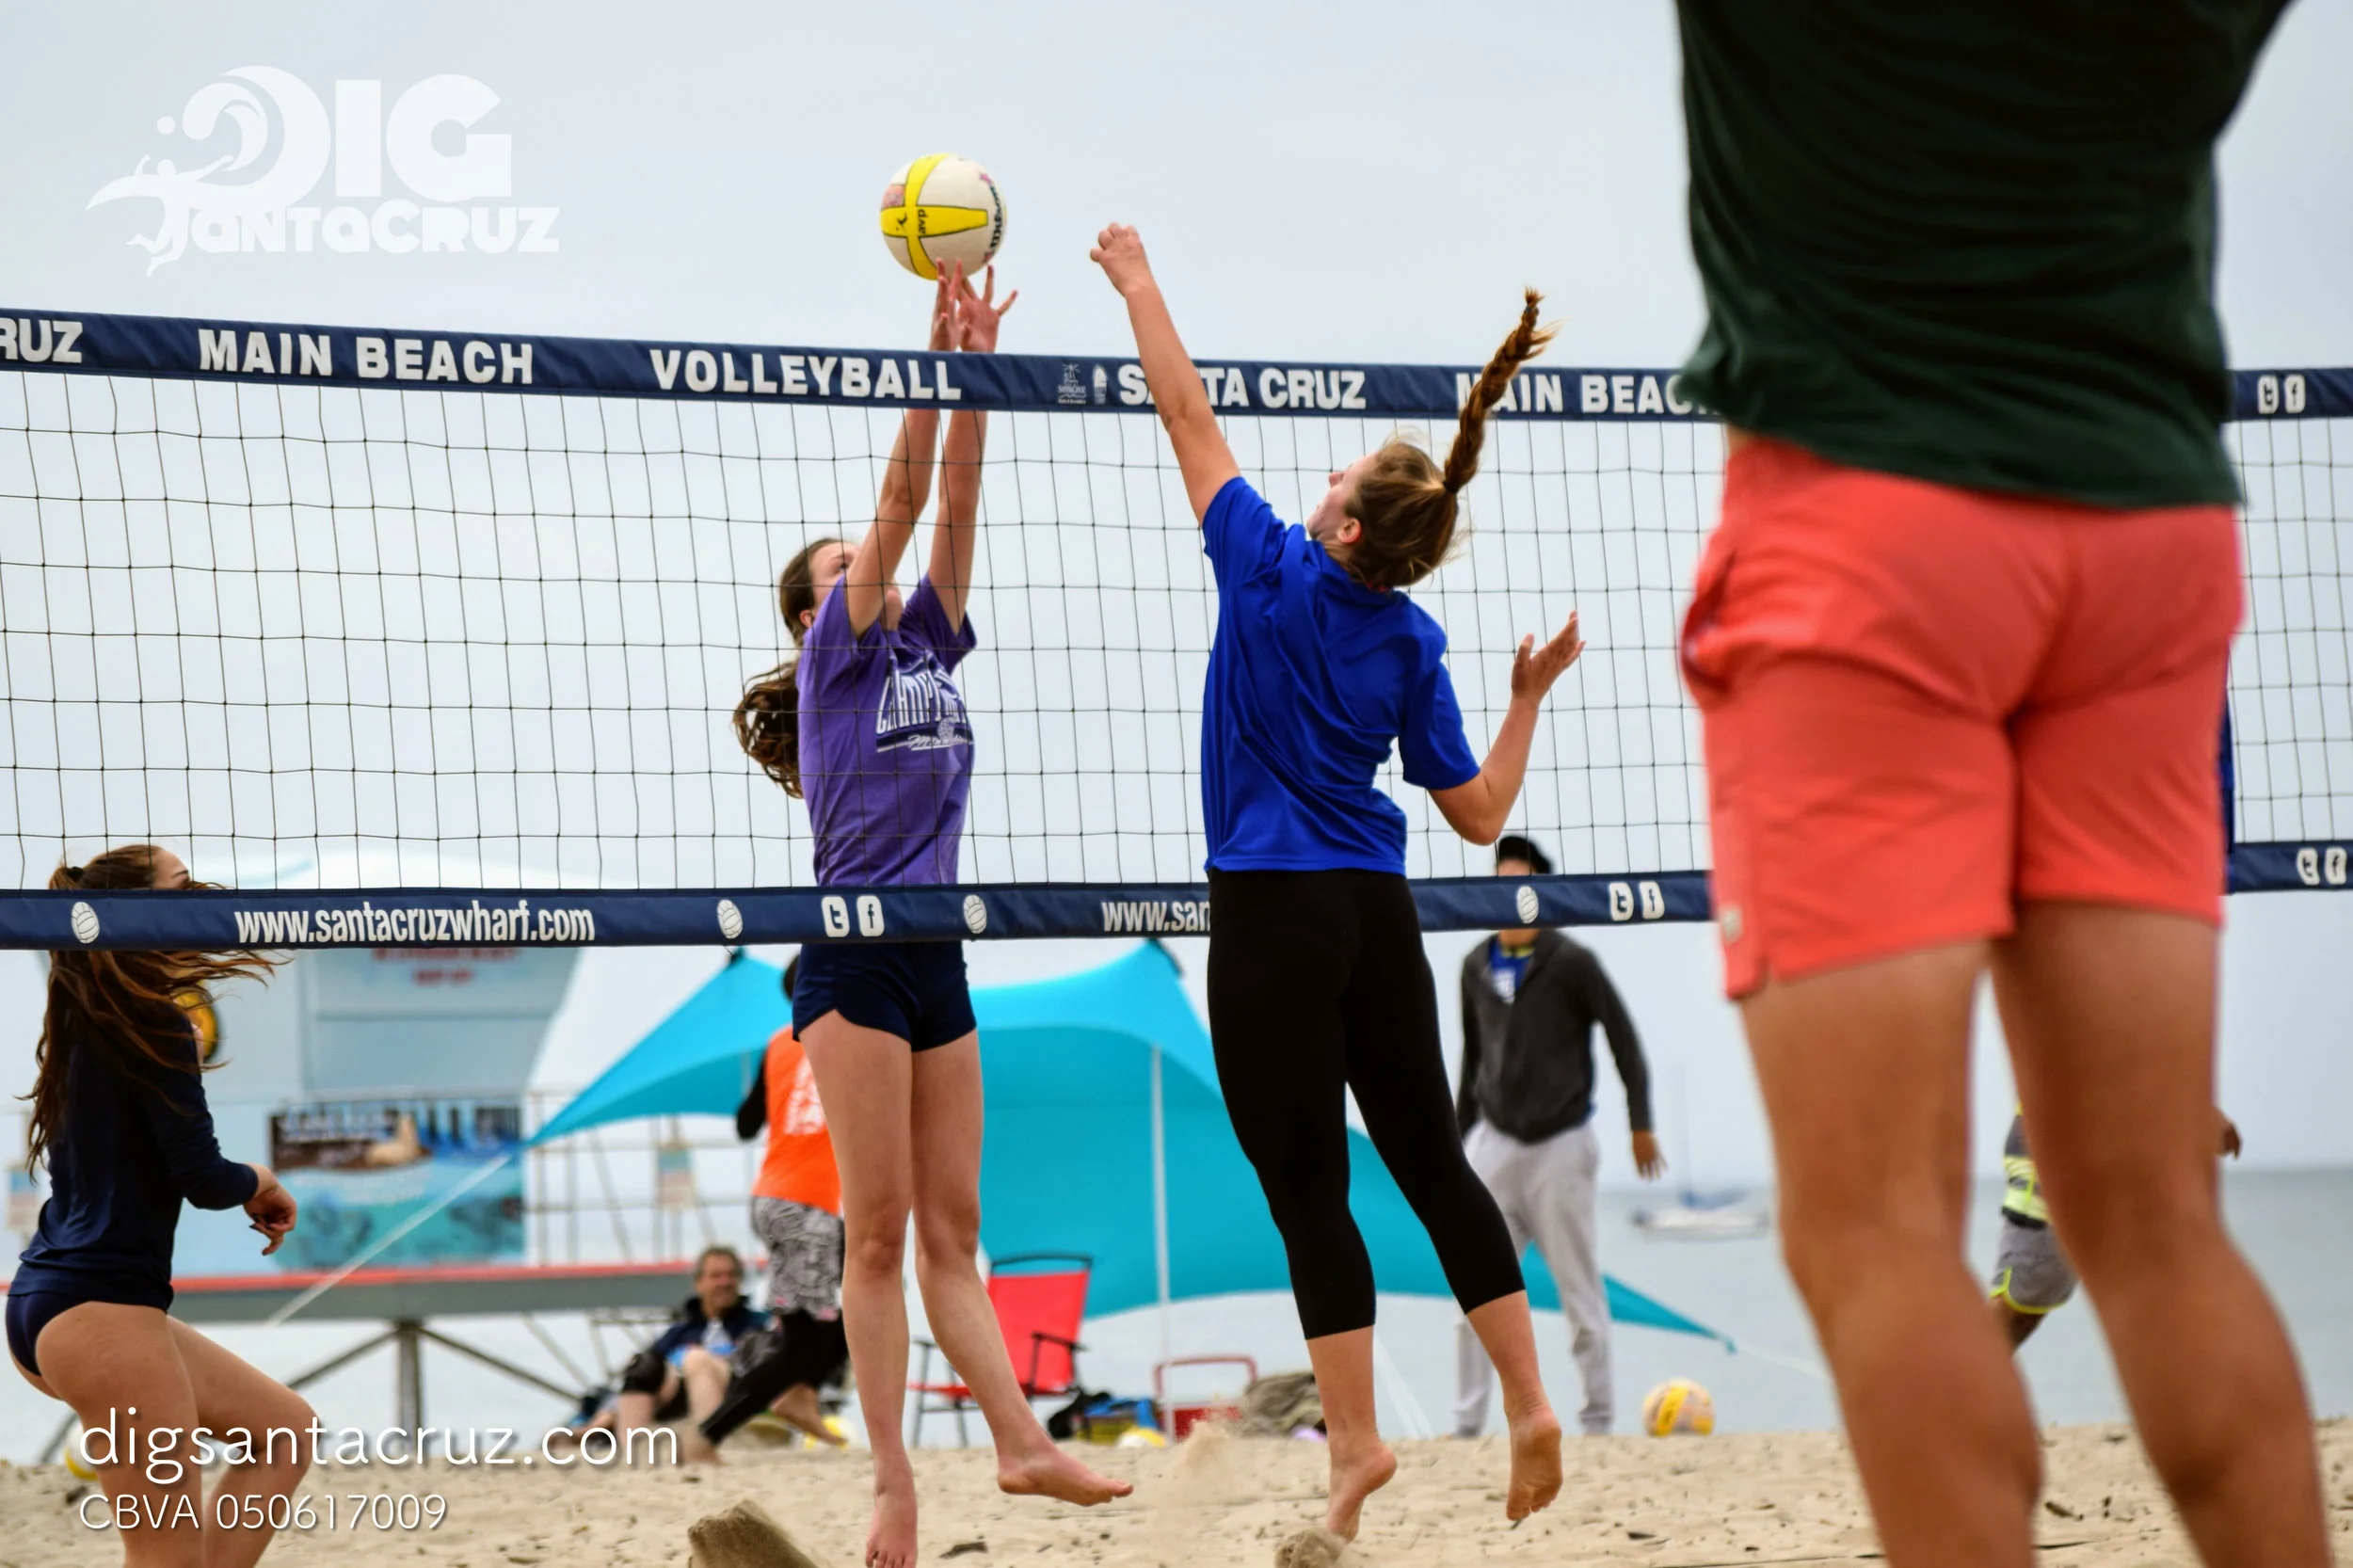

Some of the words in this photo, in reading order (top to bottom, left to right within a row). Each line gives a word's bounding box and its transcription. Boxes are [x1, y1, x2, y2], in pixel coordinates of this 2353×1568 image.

[198, 328, 333, 376] MAIN
[356, 337, 534, 385] BEACH
[649, 349, 963, 401] VOLLEYBALL
[1117, 363, 1251, 408] STA
[1258, 367, 1367, 409] CRUZ
[1580, 375, 1719, 415] BEAC
[233, 900, 596, 943] www.santacruzwharf.com
